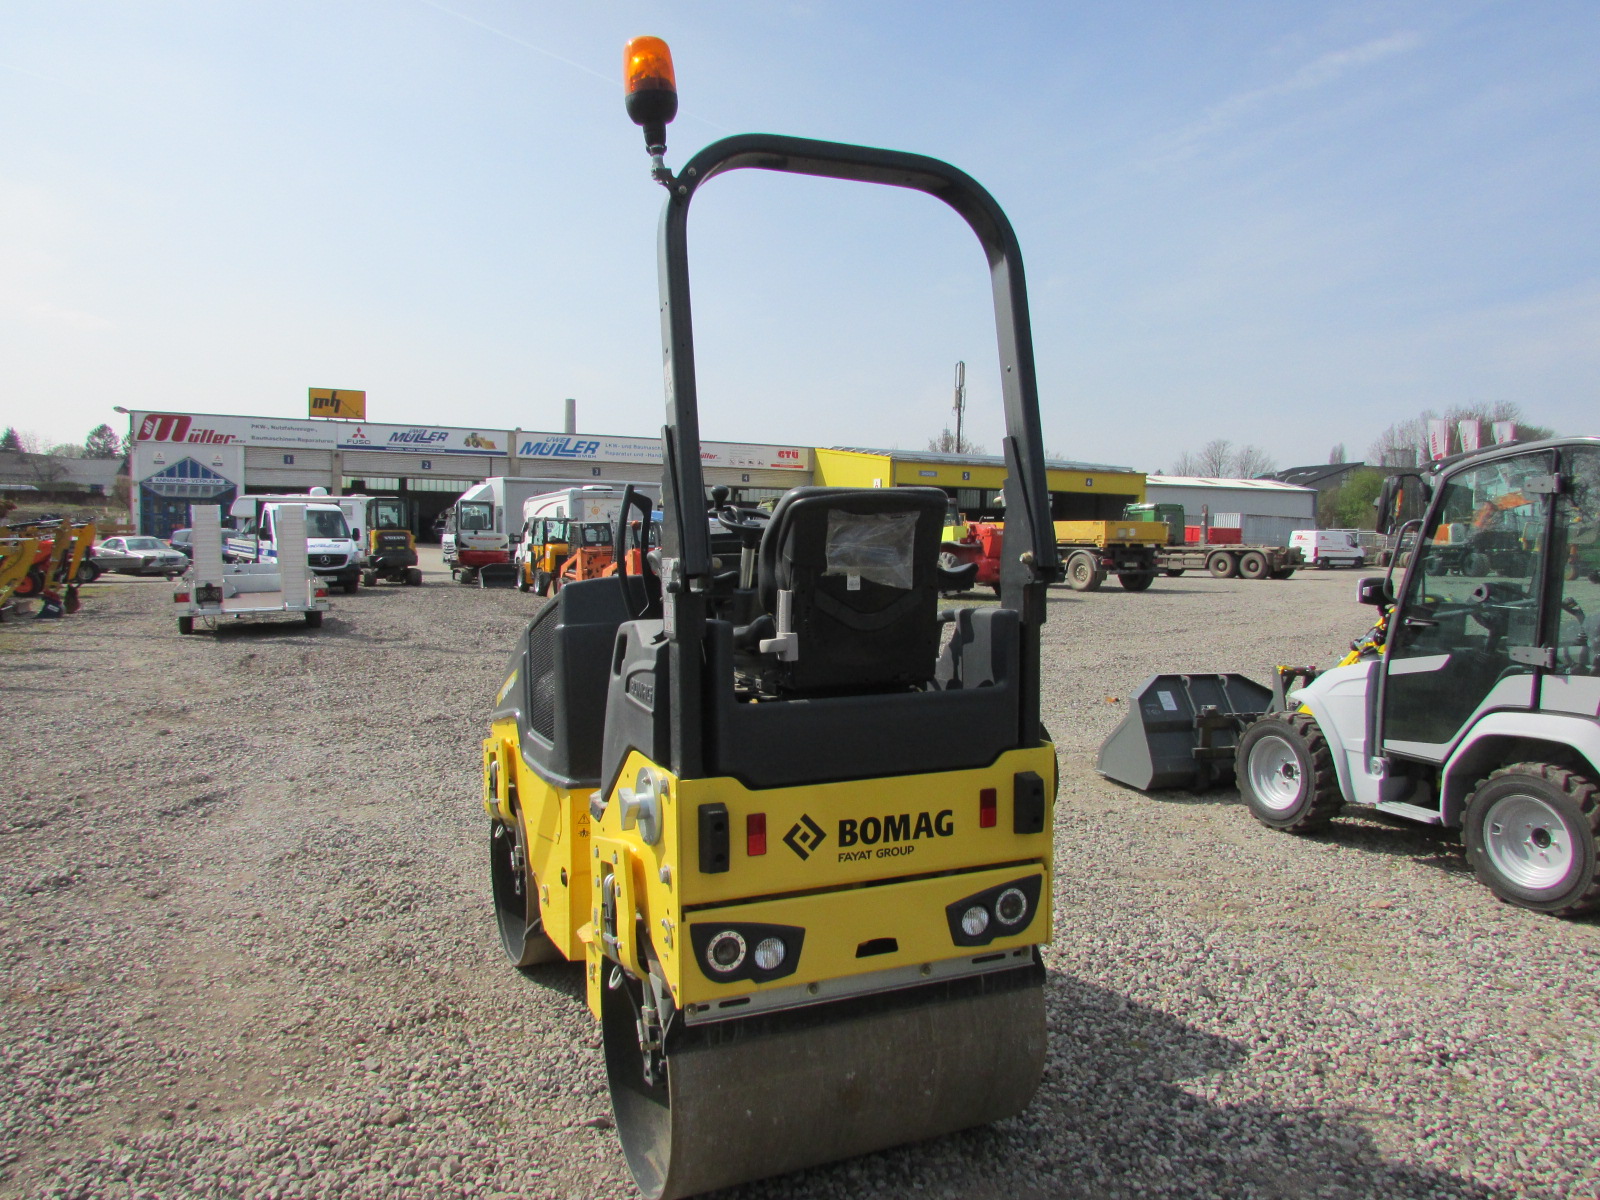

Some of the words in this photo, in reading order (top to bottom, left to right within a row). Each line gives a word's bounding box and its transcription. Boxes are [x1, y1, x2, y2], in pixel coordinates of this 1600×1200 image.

[137, 414, 236, 444] Müller
[388, 430, 449, 444] MÜLLER
[519, 439, 600, 457] MÜLLER
[778, 449, 798, 459] GTÜ
[838, 809, 954, 848] BOMAG
[838, 850, 872, 863] FAYAT
[876, 845, 915, 858] GROUP
